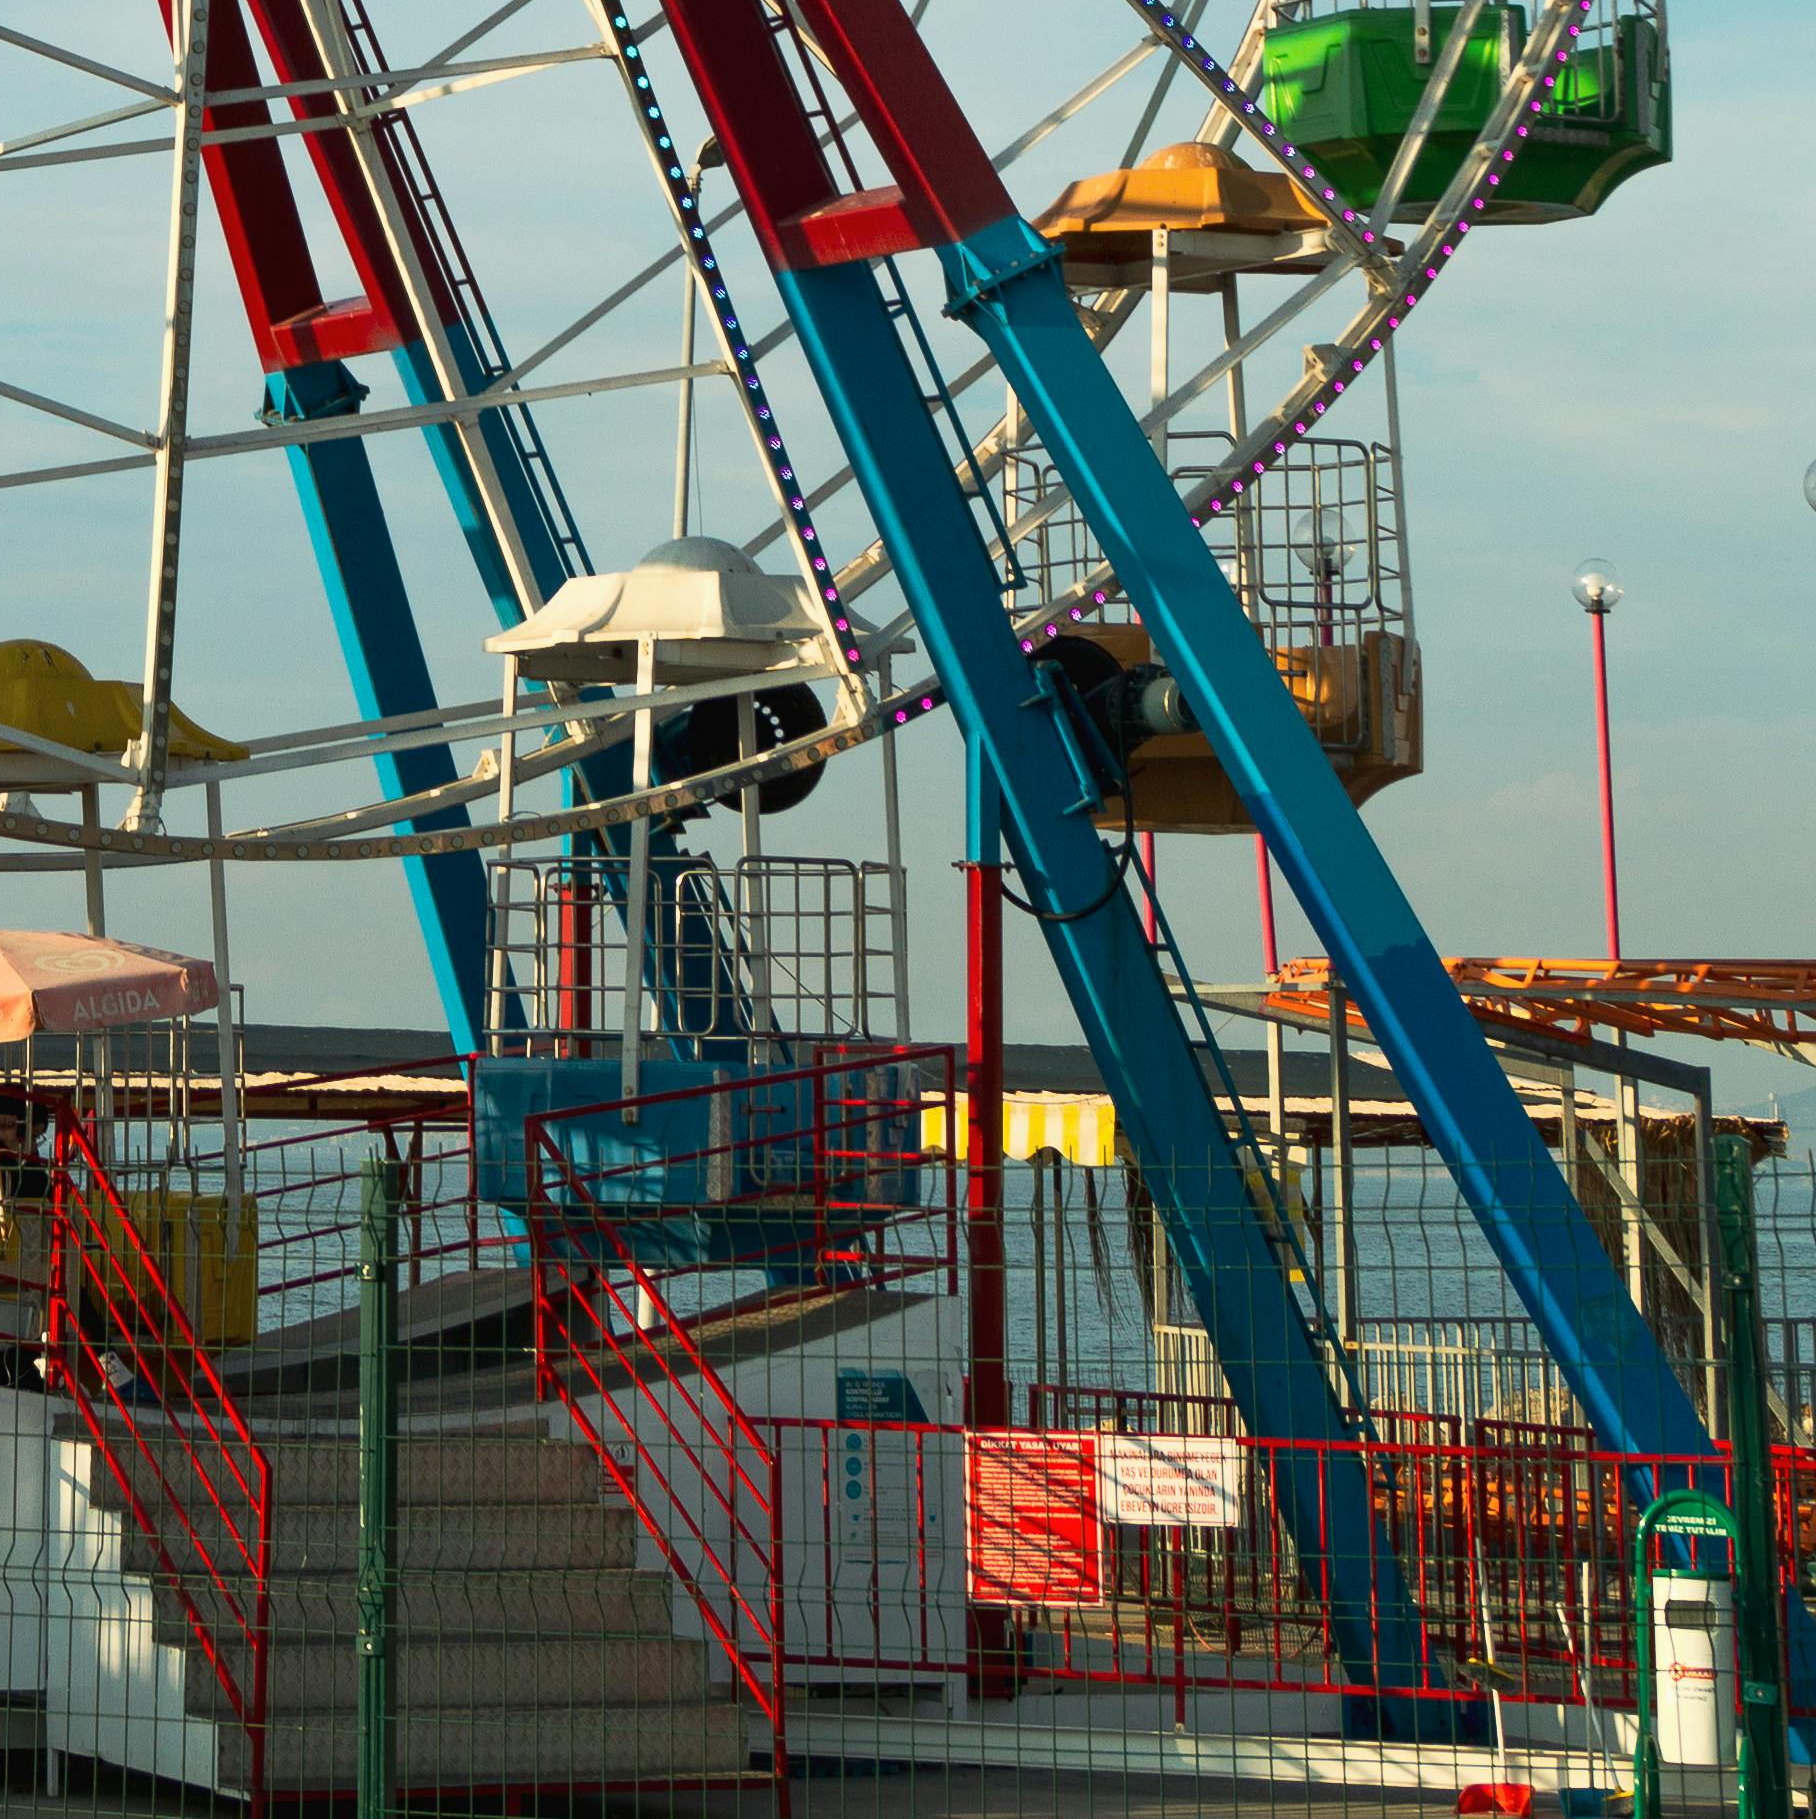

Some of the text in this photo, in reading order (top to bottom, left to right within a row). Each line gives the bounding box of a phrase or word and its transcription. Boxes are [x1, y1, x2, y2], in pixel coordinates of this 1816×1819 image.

[1053, 1442, 1082, 1451] UYAR
[1120, 1466, 1136, 1480] YAŞ
[1139, 1467, 1150, 1479] VE
[1195, 1468, 1218, 1481] OLAN
[1179, 1485, 1216, 1498] YNINDA
